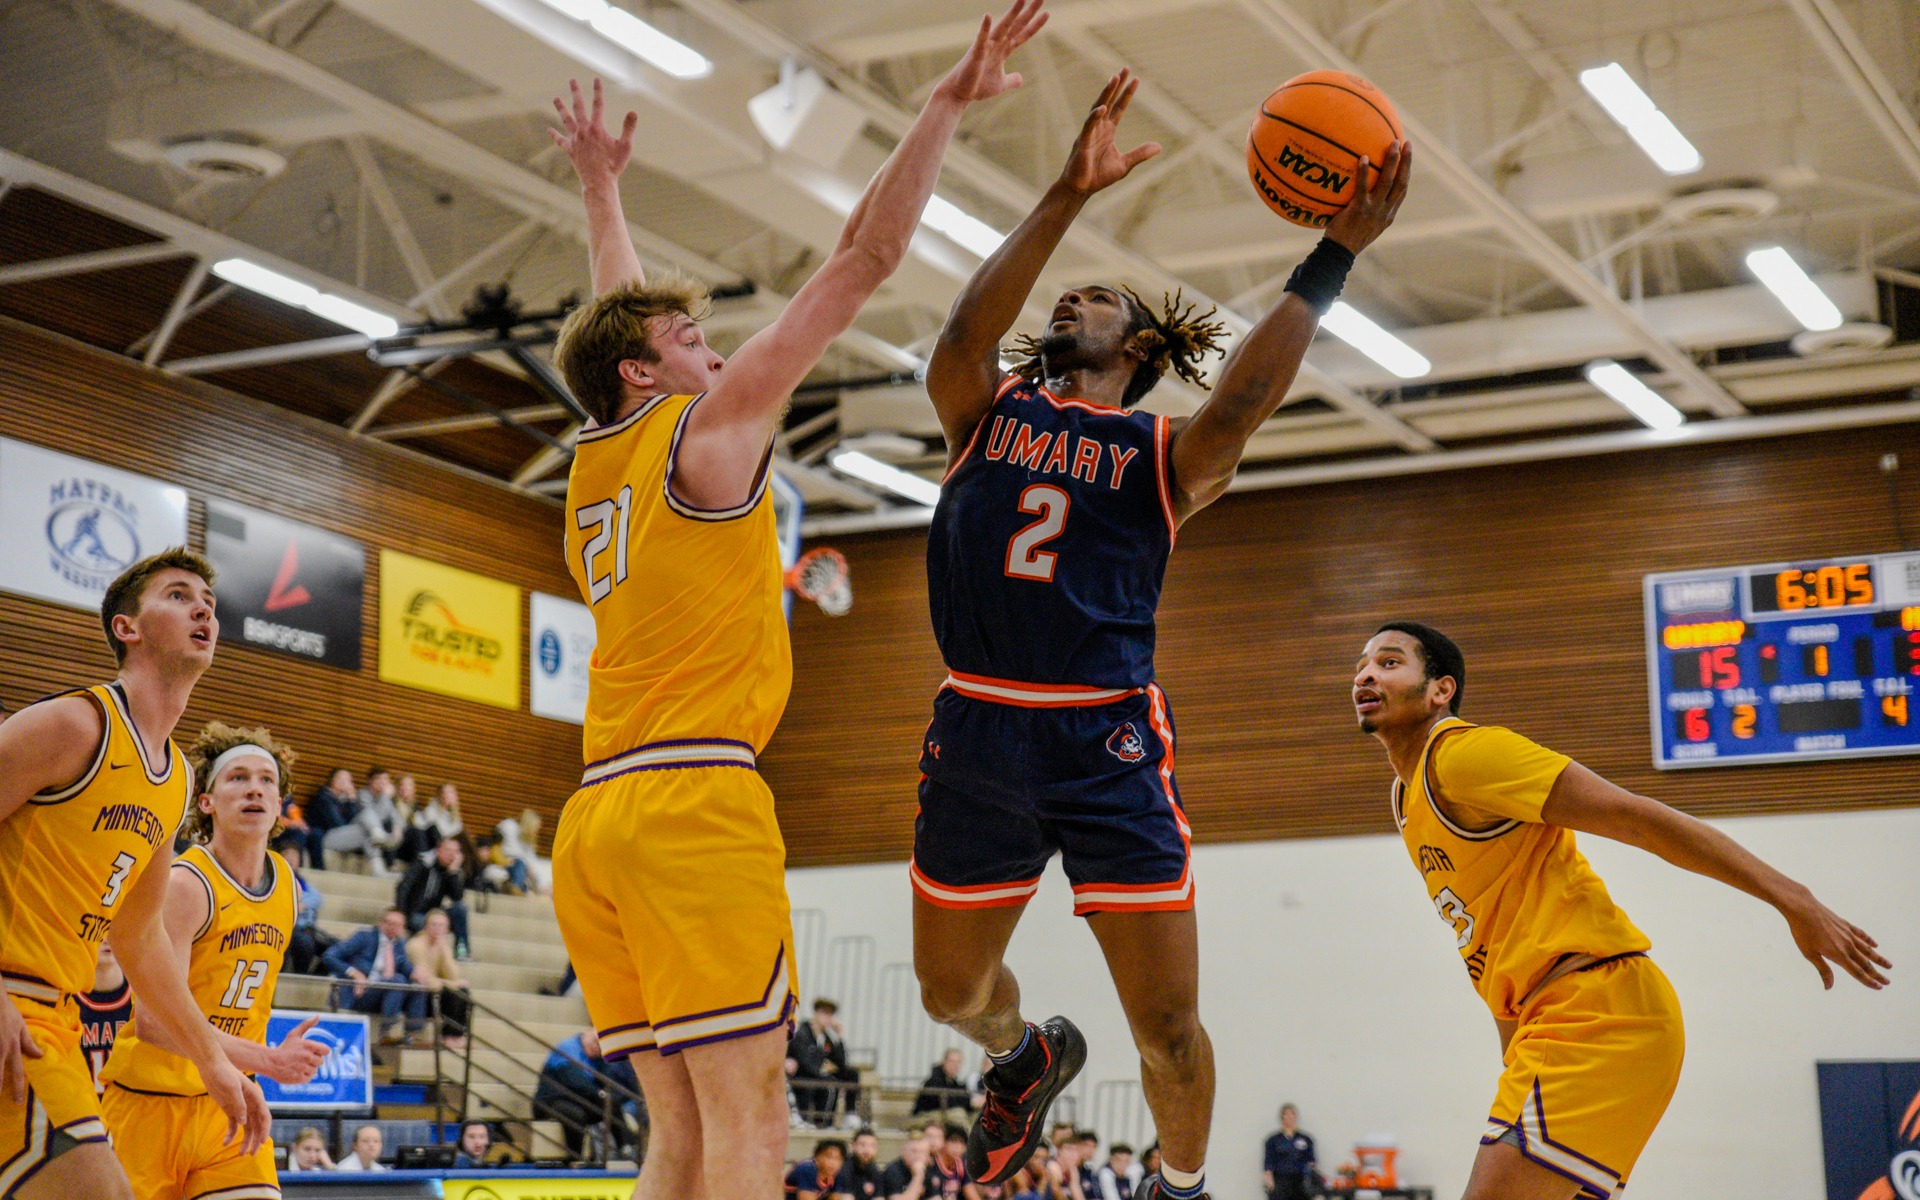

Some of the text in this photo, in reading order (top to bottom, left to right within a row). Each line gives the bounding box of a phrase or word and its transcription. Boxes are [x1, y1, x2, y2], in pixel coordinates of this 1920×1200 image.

[1278, 144, 1350, 194] NCAA
[985, 415, 1138, 490] UMARY
[575, 483, 632, 606] 21
[1003, 482, 1071, 583] 2
[1775, 563, 1874, 611] 6:05
[401, 616, 502, 660] TRUSTED
[1699, 646, 1742, 690] 15
[1814, 644, 1830, 677] 1
[1683, 706, 1711, 742] 6
[1731, 703, 1757, 739] 2
[1881, 694, 1909, 727] 4
[101, 850, 137, 908] 3
[219, 922, 285, 956] MINNESOTA
[219, 958, 270, 1011] 12
[207, 1014, 249, 1037] STATE
